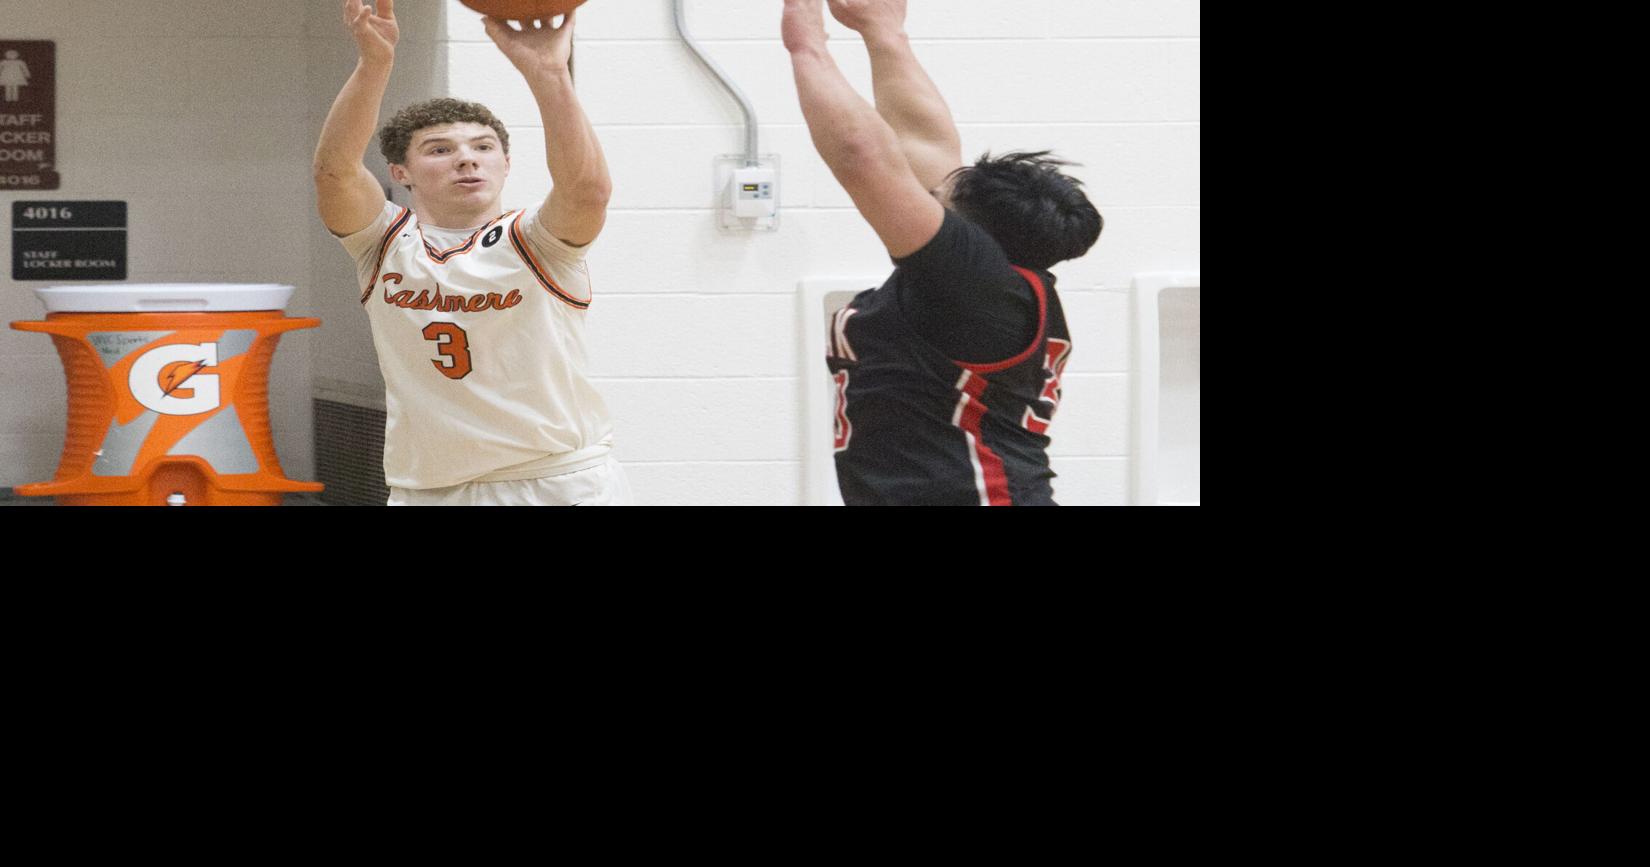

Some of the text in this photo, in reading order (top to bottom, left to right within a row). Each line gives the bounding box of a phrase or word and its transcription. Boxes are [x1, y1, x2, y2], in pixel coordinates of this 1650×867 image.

[23, 207, 73, 219] 4016
[23, 251, 57, 259] STAFF
[23, 260, 117, 269] LOCKER ROOM
[382, 272, 523, 313] Cashmere
[422, 321, 473, 380] 3
[128, 342, 222, 417] G
